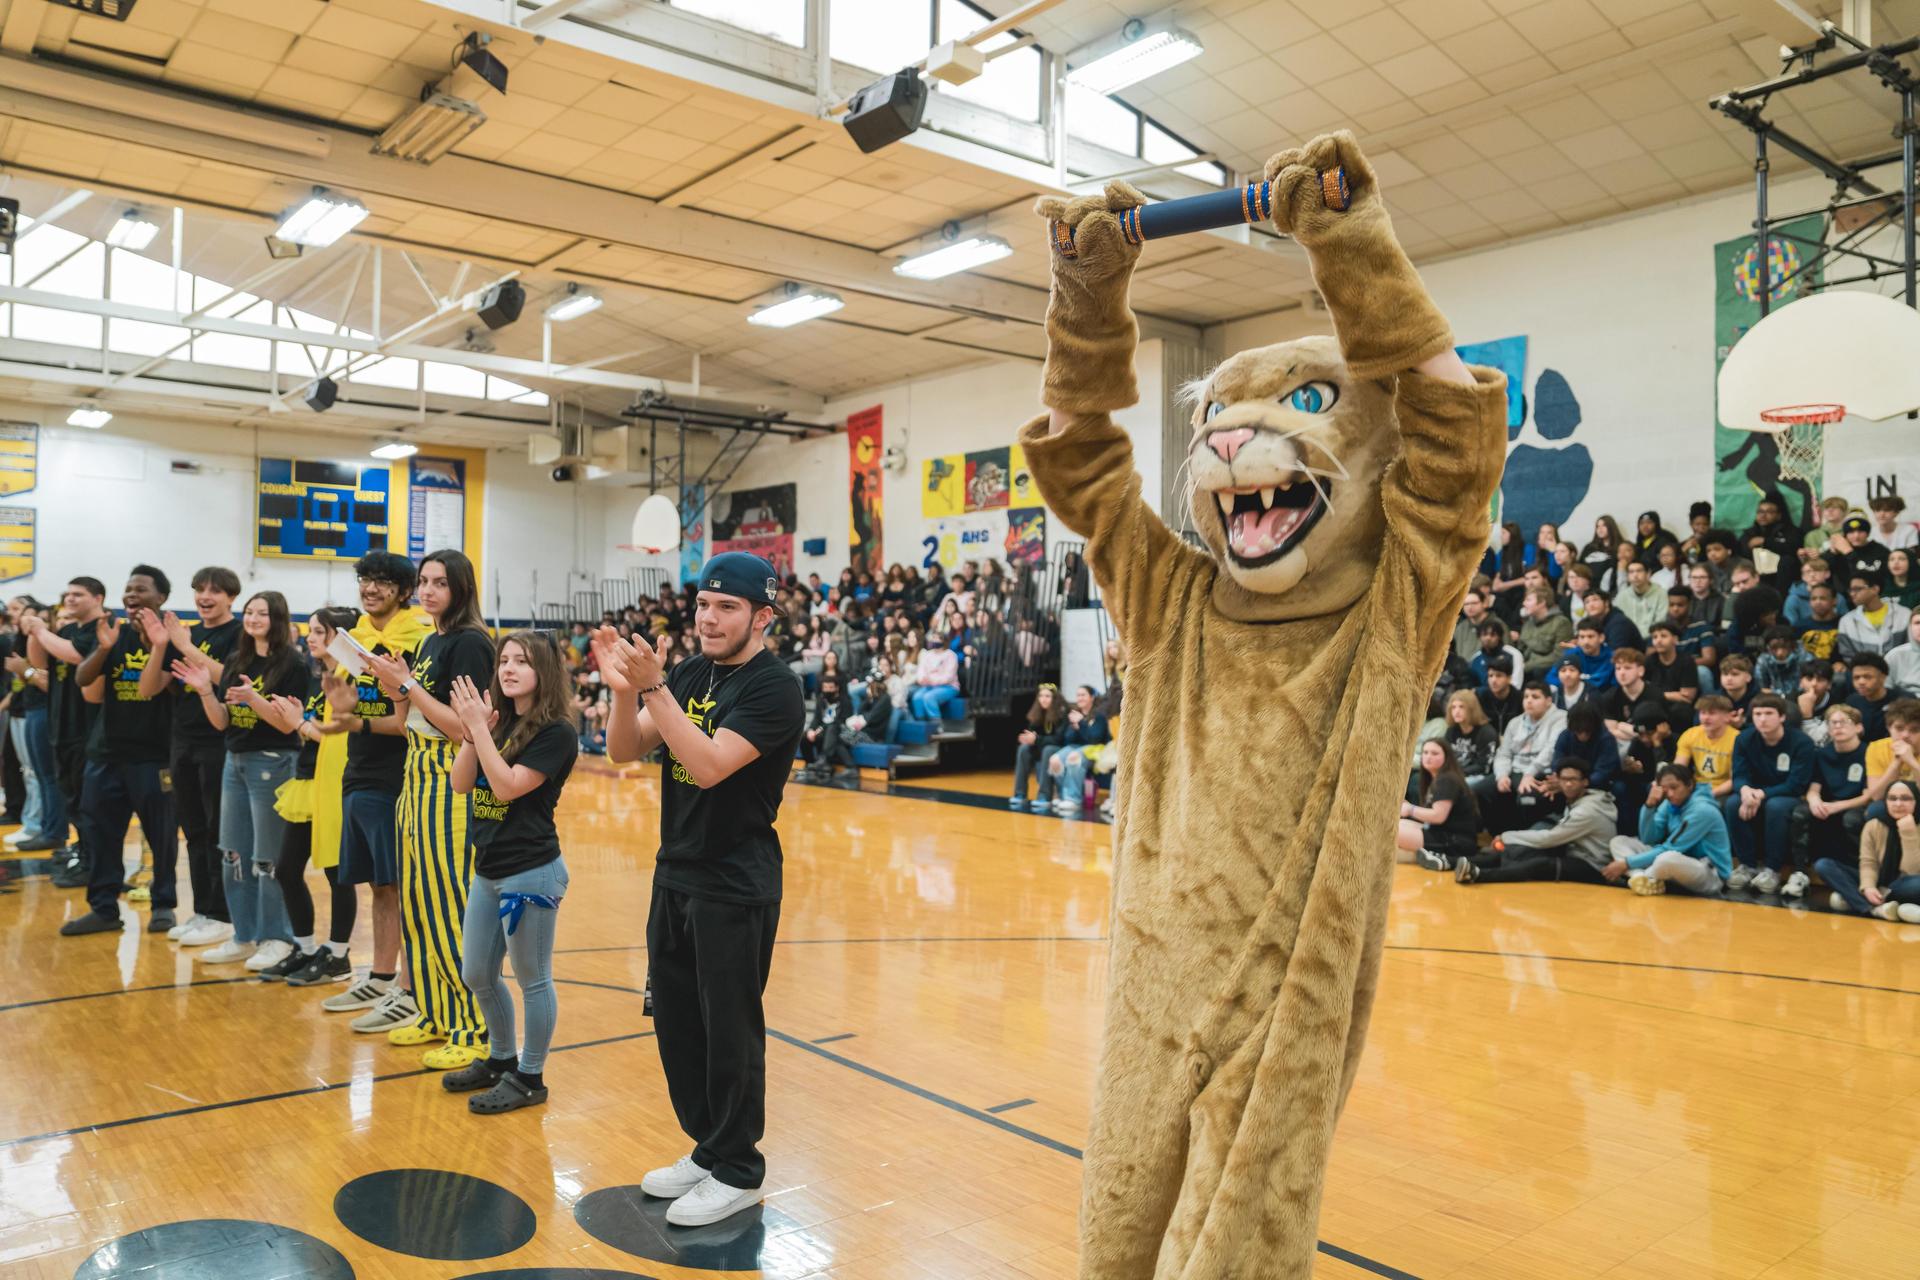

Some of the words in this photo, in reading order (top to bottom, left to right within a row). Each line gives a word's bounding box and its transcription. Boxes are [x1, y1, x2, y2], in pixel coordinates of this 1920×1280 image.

[1866, 473, 1897, 501] IN
[961, 529, 990, 544] AHS
[922, 533, 958, 568] 26
[358, 686, 380, 701] 024
[672, 763, 698, 785] COU
